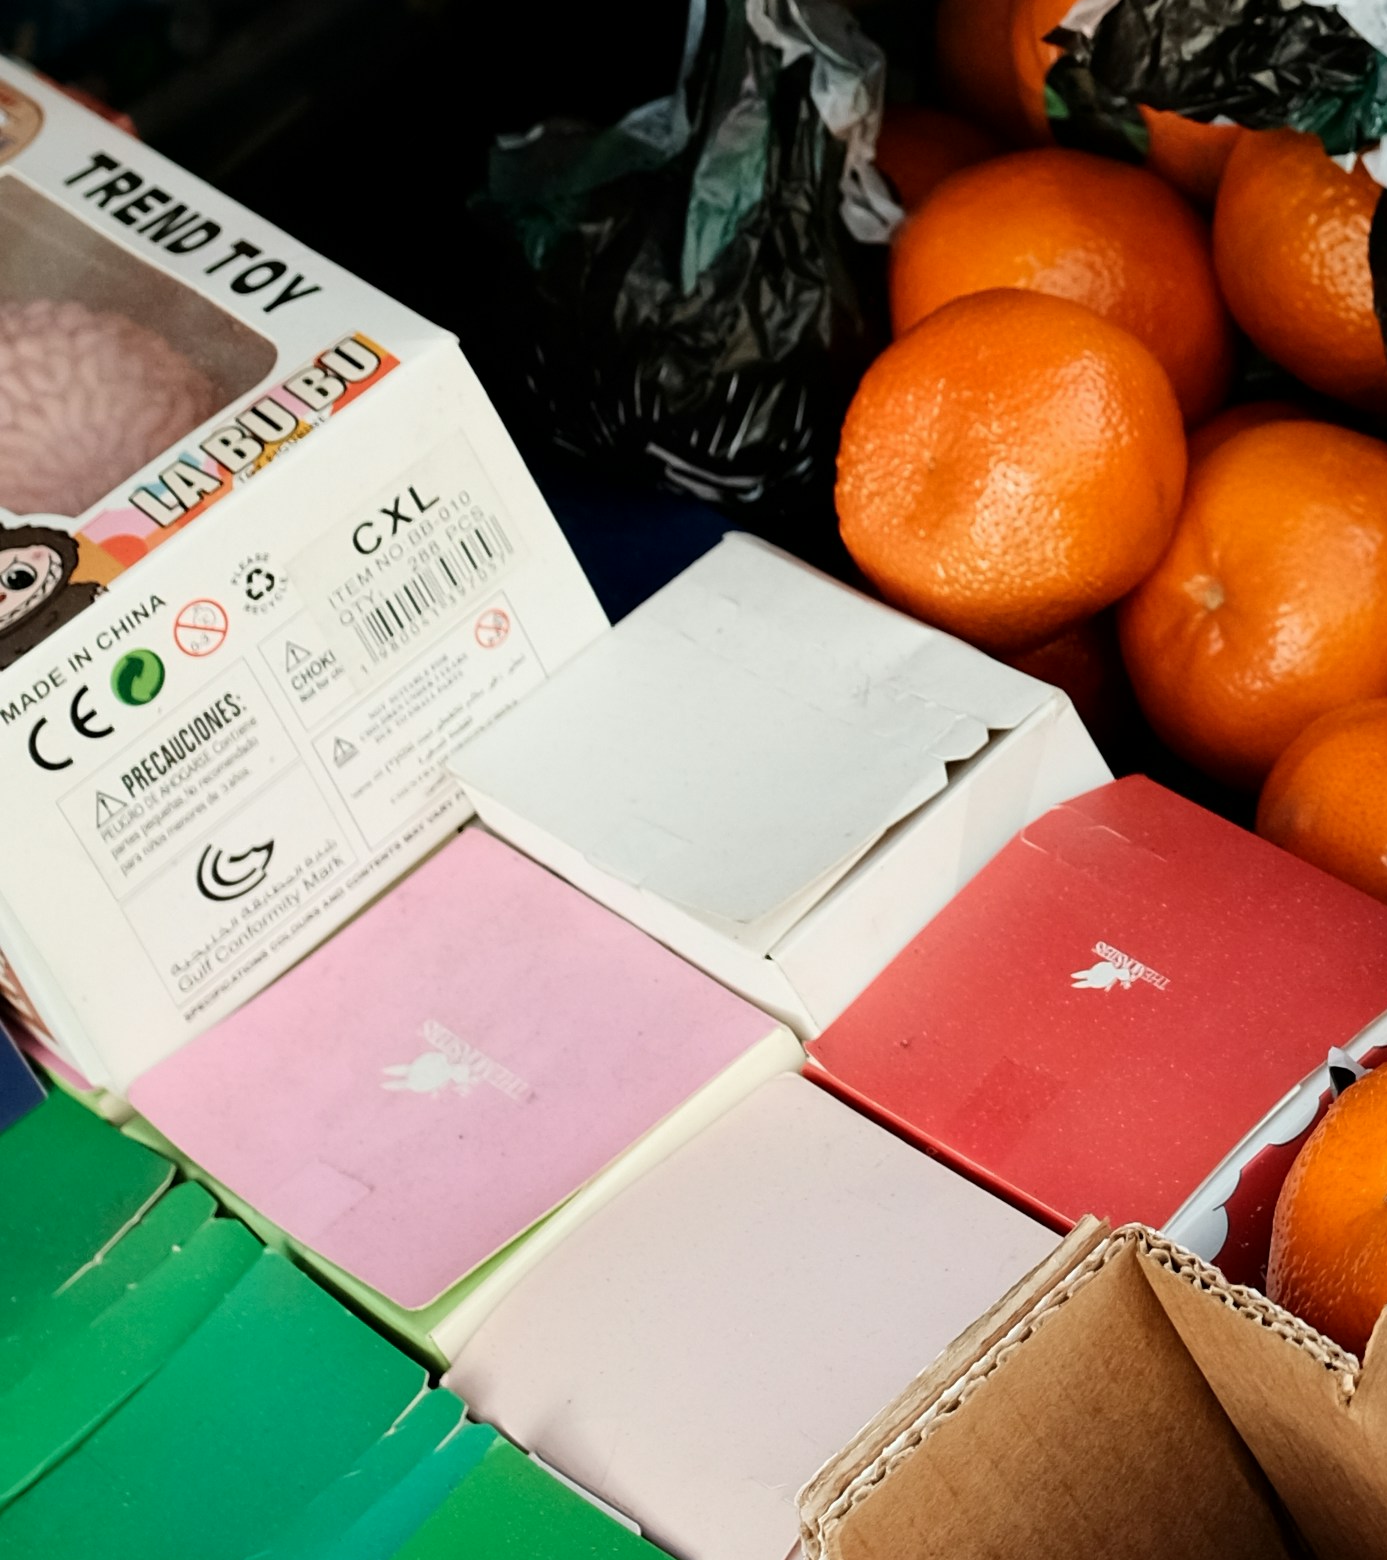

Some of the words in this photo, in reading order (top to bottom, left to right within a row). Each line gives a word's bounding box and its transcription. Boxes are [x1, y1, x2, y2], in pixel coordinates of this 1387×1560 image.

[64, 150, 222, 257] TREND
[209, 239, 323, 314] TOY
[351, 486, 439, 556] CXL
[328, 566, 374, 610] ITEM
[0, 671, 61, 725] MADE
[67, 647, 93, 672] IN
[95, 594, 166, 651] CHINA
[291, 650, 336, 691] CHOKI
[120, 692, 248, 798] PRECAUCIONES:
[177, 952, 213, 993] Gulf
[214, 890, 301, 964] Conformity
[302, 857, 344, 892] Mark
